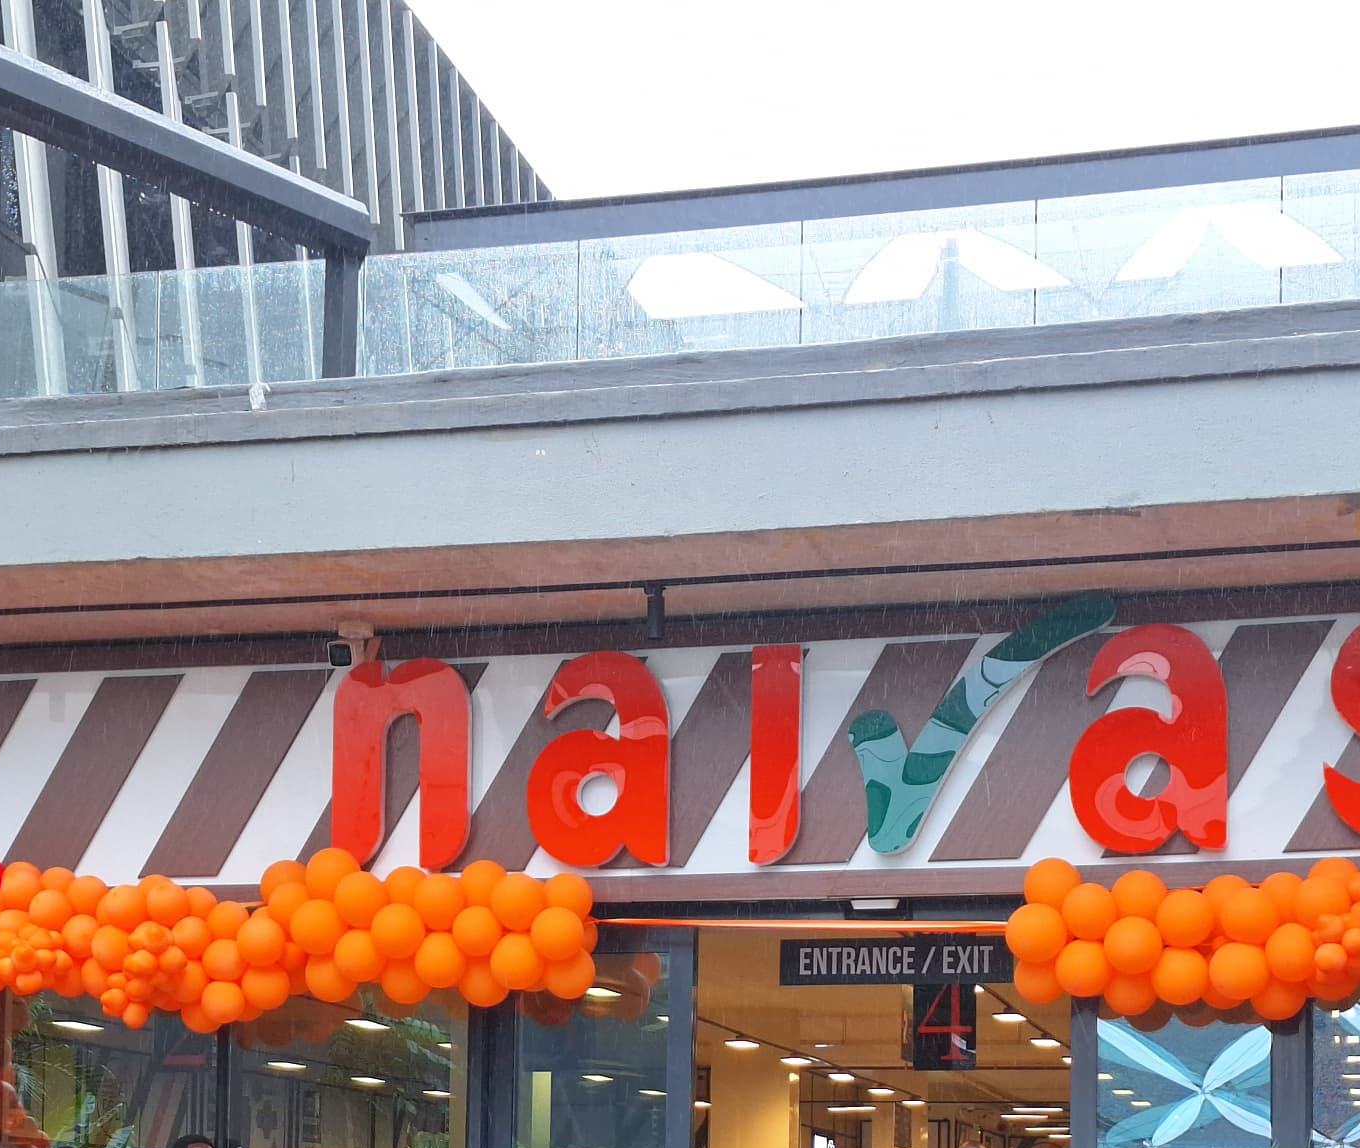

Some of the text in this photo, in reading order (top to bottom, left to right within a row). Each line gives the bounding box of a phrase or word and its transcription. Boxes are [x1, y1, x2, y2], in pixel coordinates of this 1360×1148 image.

[798, 946, 916, 976] ENTRANCE
[942, 945, 994, 974] EXIT
[917, 984, 973, 1061] 4
